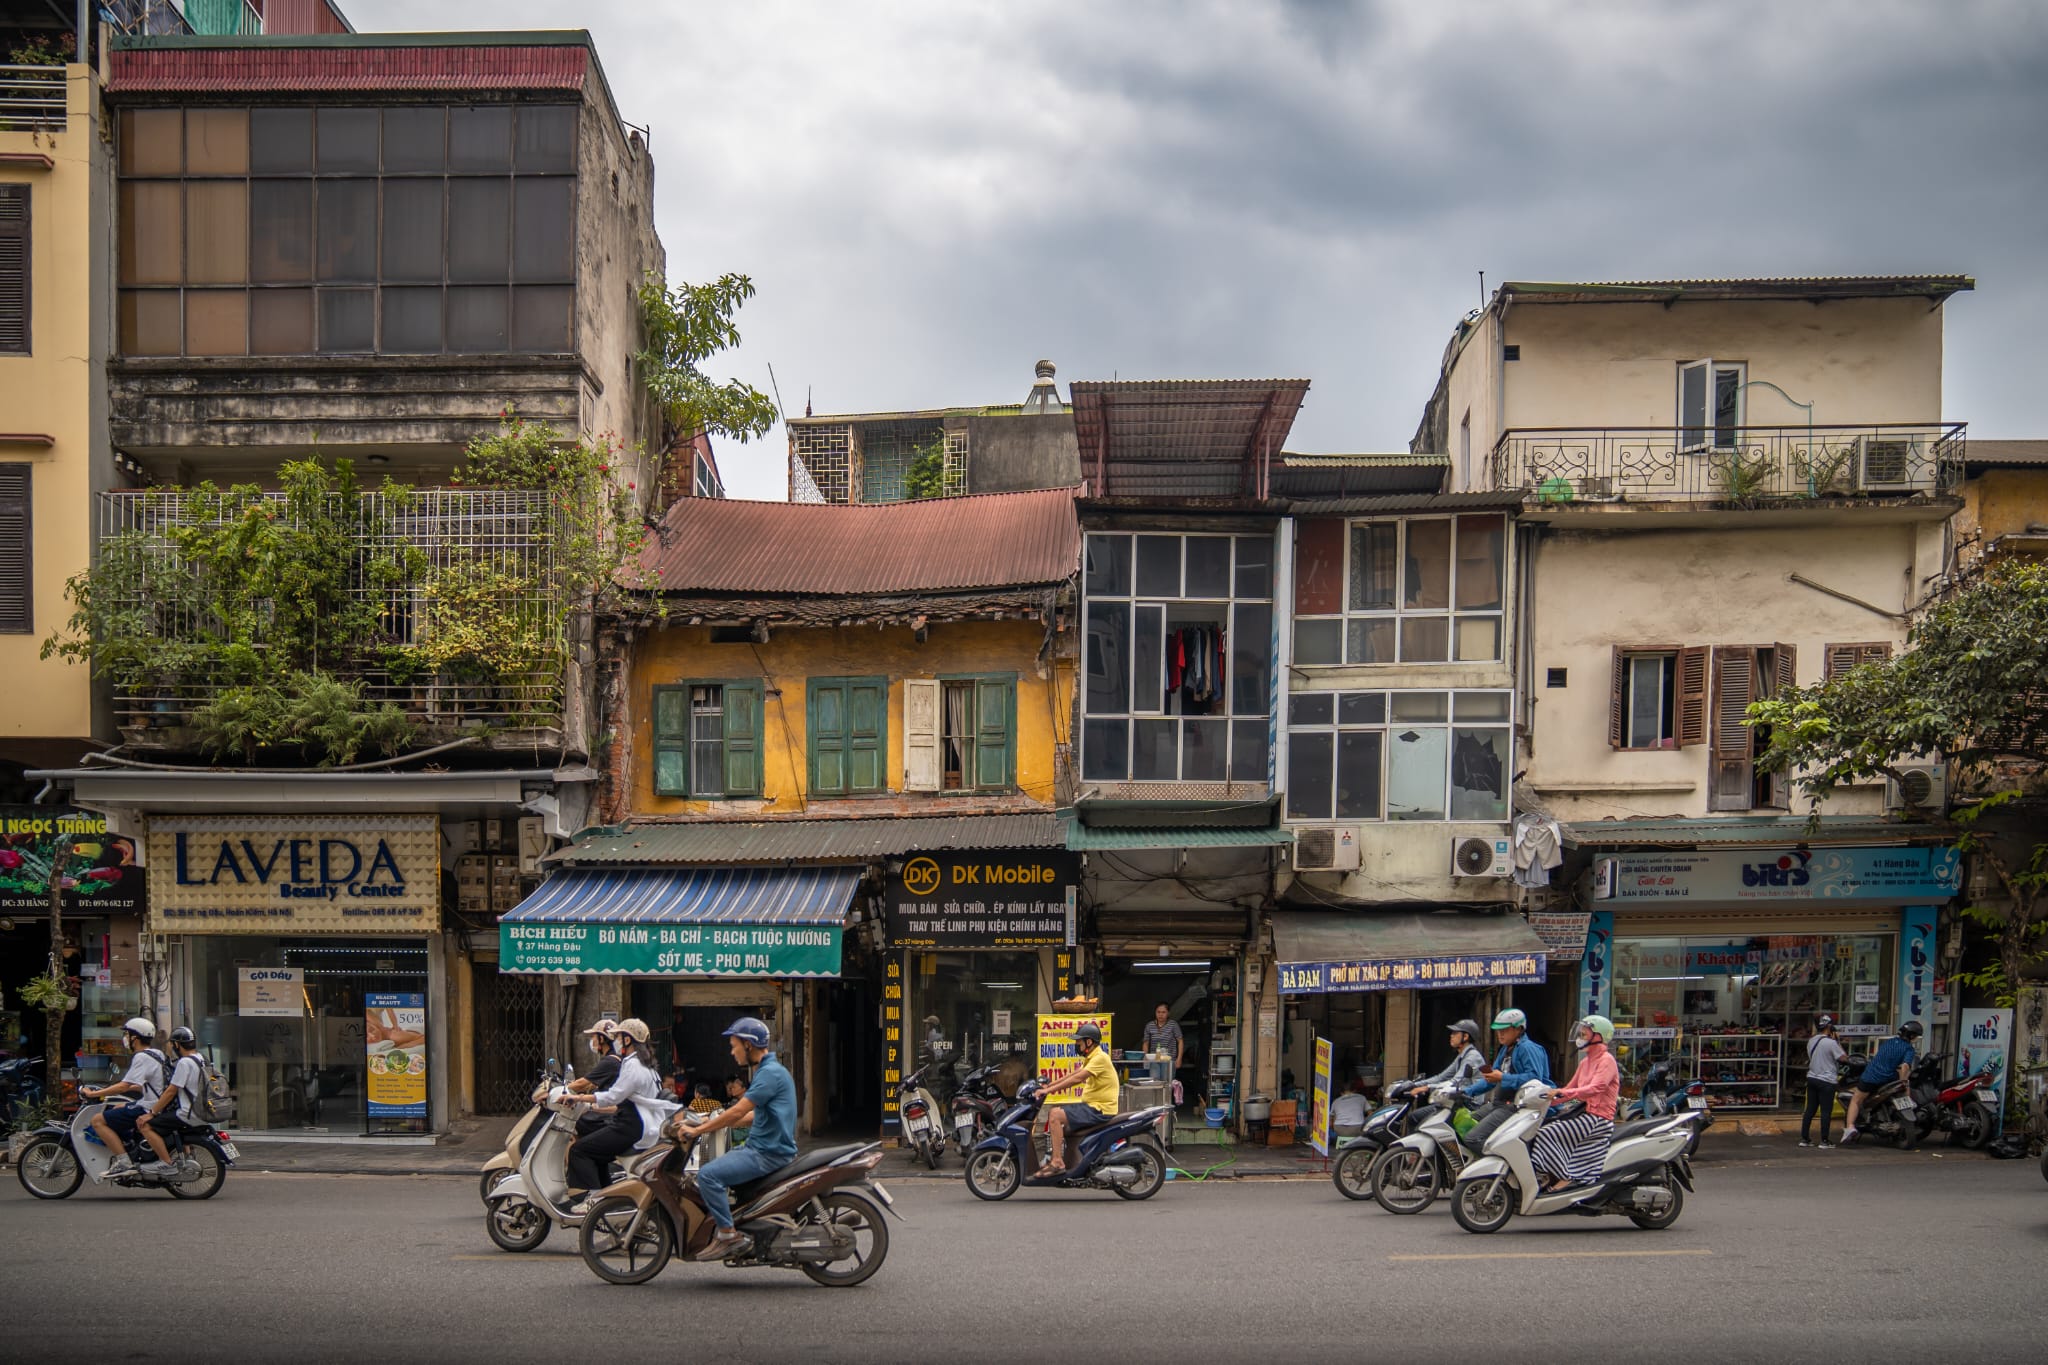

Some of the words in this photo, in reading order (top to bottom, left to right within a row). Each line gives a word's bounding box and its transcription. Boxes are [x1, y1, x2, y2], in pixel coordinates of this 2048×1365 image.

[8, 819, 53, 839] NGỌC
[176, 832, 405, 885] LAVEDA
[952, 865, 980, 884] DK
[985, 864, 1056, 884] Mobile
[280, 883, 338, 901] Beauty
[347, 882, 405, 897] Center
[26, 898, 49, 907] HÀNG
[899, 903, 917, 914] MUA
[920, 901, 938, 914] BÁN
[943, 899, 961, 914] SỬA
[993, 900, 1004, 914] ÉP
[1007, 901, 1026, 914] KÍNH
[1030, 899, 1046, 914] LẤY
[510, 925, 546, 939] BÍCH
[549, 924, 587, 939] HIẾU
[909, 920, 928, 932] THAY
[930, 918, 947, 932] THẾ
[947, 920, 967, 932] LINH
[969, 920, 986, 934] PHỤ
[988, 918, 1007, 934] KIỆN
[1009, 918, 1036, 932] CHÍNH
[599, 926, 616, 944] BÒ
[660, 930, 677, 944] BA
[713, 930, 747, 948] BẠCH
[751, 928, 784, 948] TUỘC
[786, 928, 831, 946] NƯỚNG
[525, 942, 535, 951] 37
[538, 942, 561, 952] Hàng
[563, 941, 581, 951] Đậu
[526, 956, 546, 964] 0912
[565, 957, 581, 965] 988
[658, 948, 681, 967] SỐT
[684, 952, 703, 967] ME
[715, 953, 741, 968] PHO
[744, 954, 770, 968] MAI
[1057, 953, 1071, 969] THAY
[1697, 951, 1745, 966] Khách
[887, 959, 900, 978] SỬA
[1330, 962, 1347, 983] PHỞ
[1421, 960, 1433, 979] BÒ
[1433, 963, 1449, 979] TIM
[1468, 961, 1484, 980] DỤC
[1491, 960, 1505, 976] GIA
[1058, 974, 1069, 991] THẾ
[1282, 965, 1296, 988] BÀ
[1298, 969, 1320, 992] ĐẠM
[399, 1013, 424, 1024] 50%
[886, 1006, 900, 1020] MUA
[1041, 1021, 1073, 1030] ANH
[886, 1026, 899, 1041] BÁN
[933, 1041, 952, 1050] OPEN
[1040, 1041, 1056, 1058] BÁNH
[888, 1048, 897, 1062] ÉP
[885, 1067, 900, 1082] KÍNH
[884, 1102, 900, 1112] NGAY
